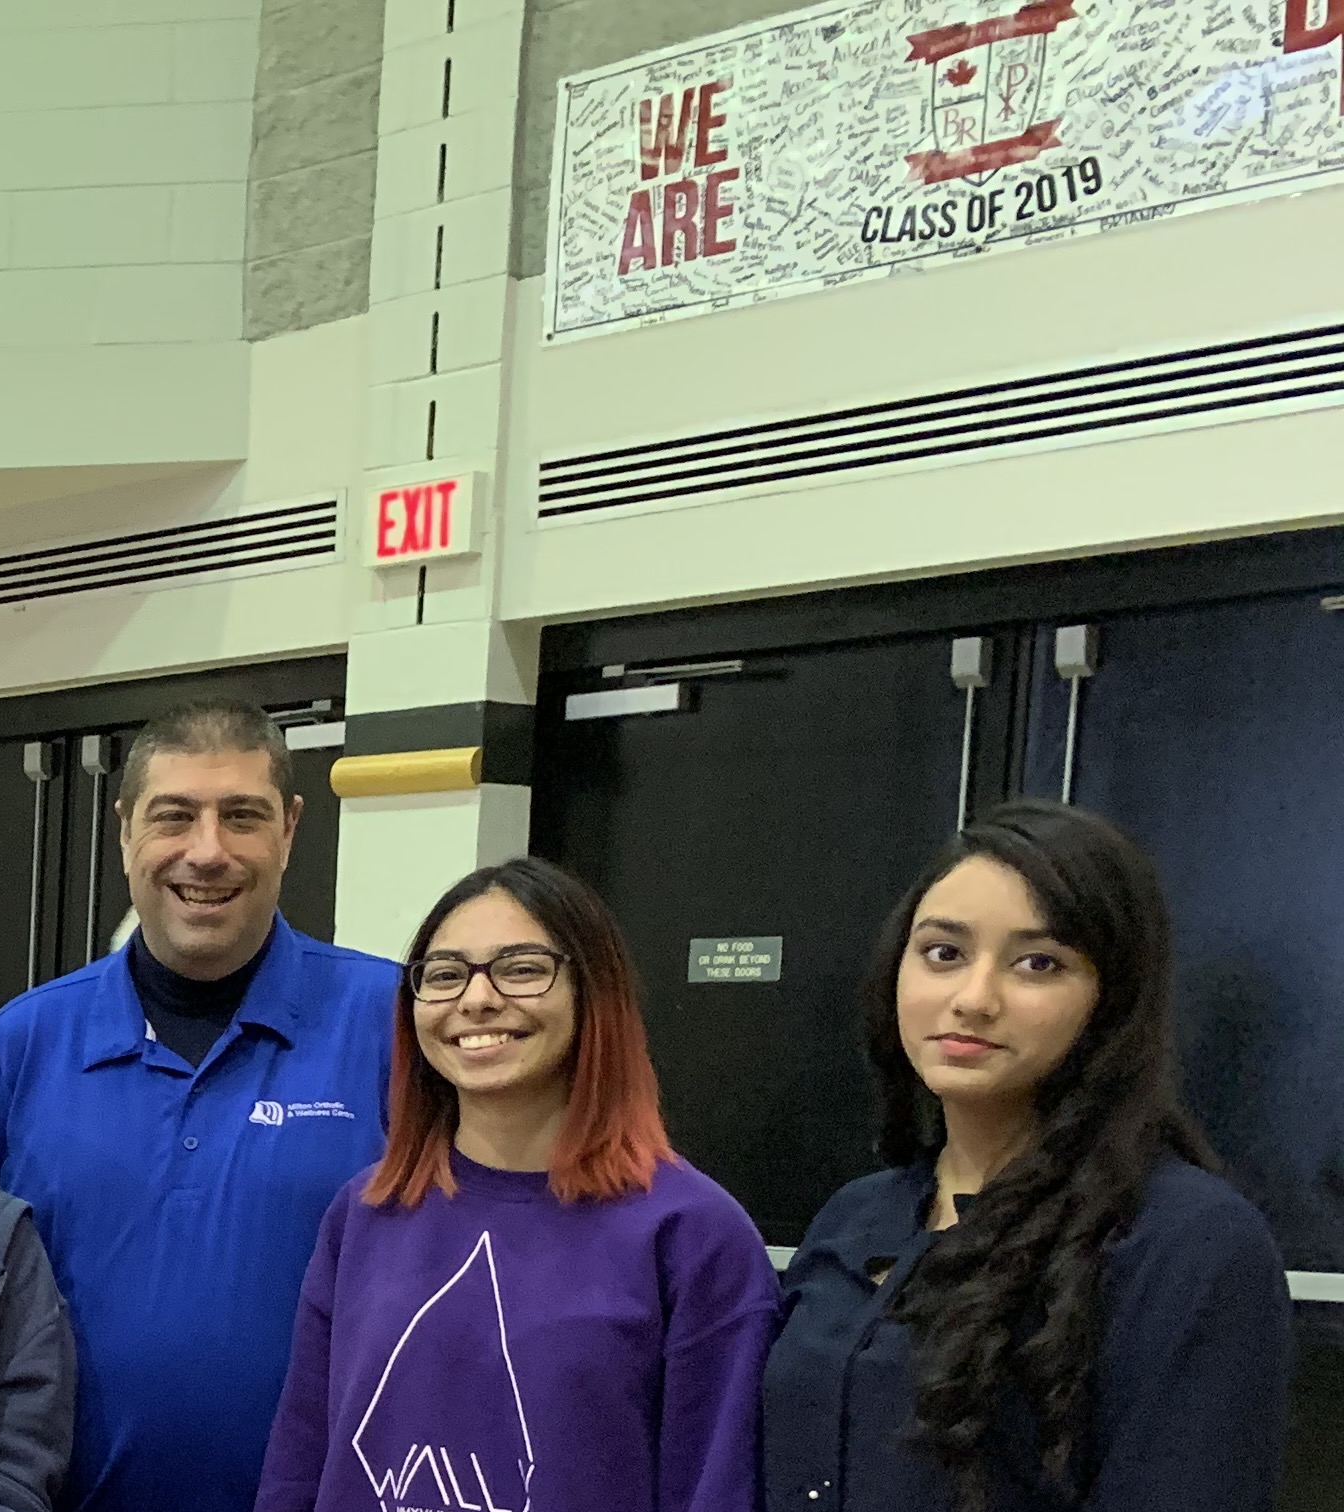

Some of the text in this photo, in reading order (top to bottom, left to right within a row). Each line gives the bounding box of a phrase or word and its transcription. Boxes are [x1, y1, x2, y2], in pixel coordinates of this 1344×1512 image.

[639, 71, 734, 181] WE
[617, 167, 740, 276] ARE
[861, 198, 957, 244] CLASS
[966, 187, 1005, 234] OF
[1014, 155, 1103, 222] 2019
[376, 480, 458, 558] EXIT
[698, 953, 772, 966] OR DRINK BEYOND
[706, 966, 762, 978] THESE DOORS
[716, 941, 755, 953] NO FOOD
